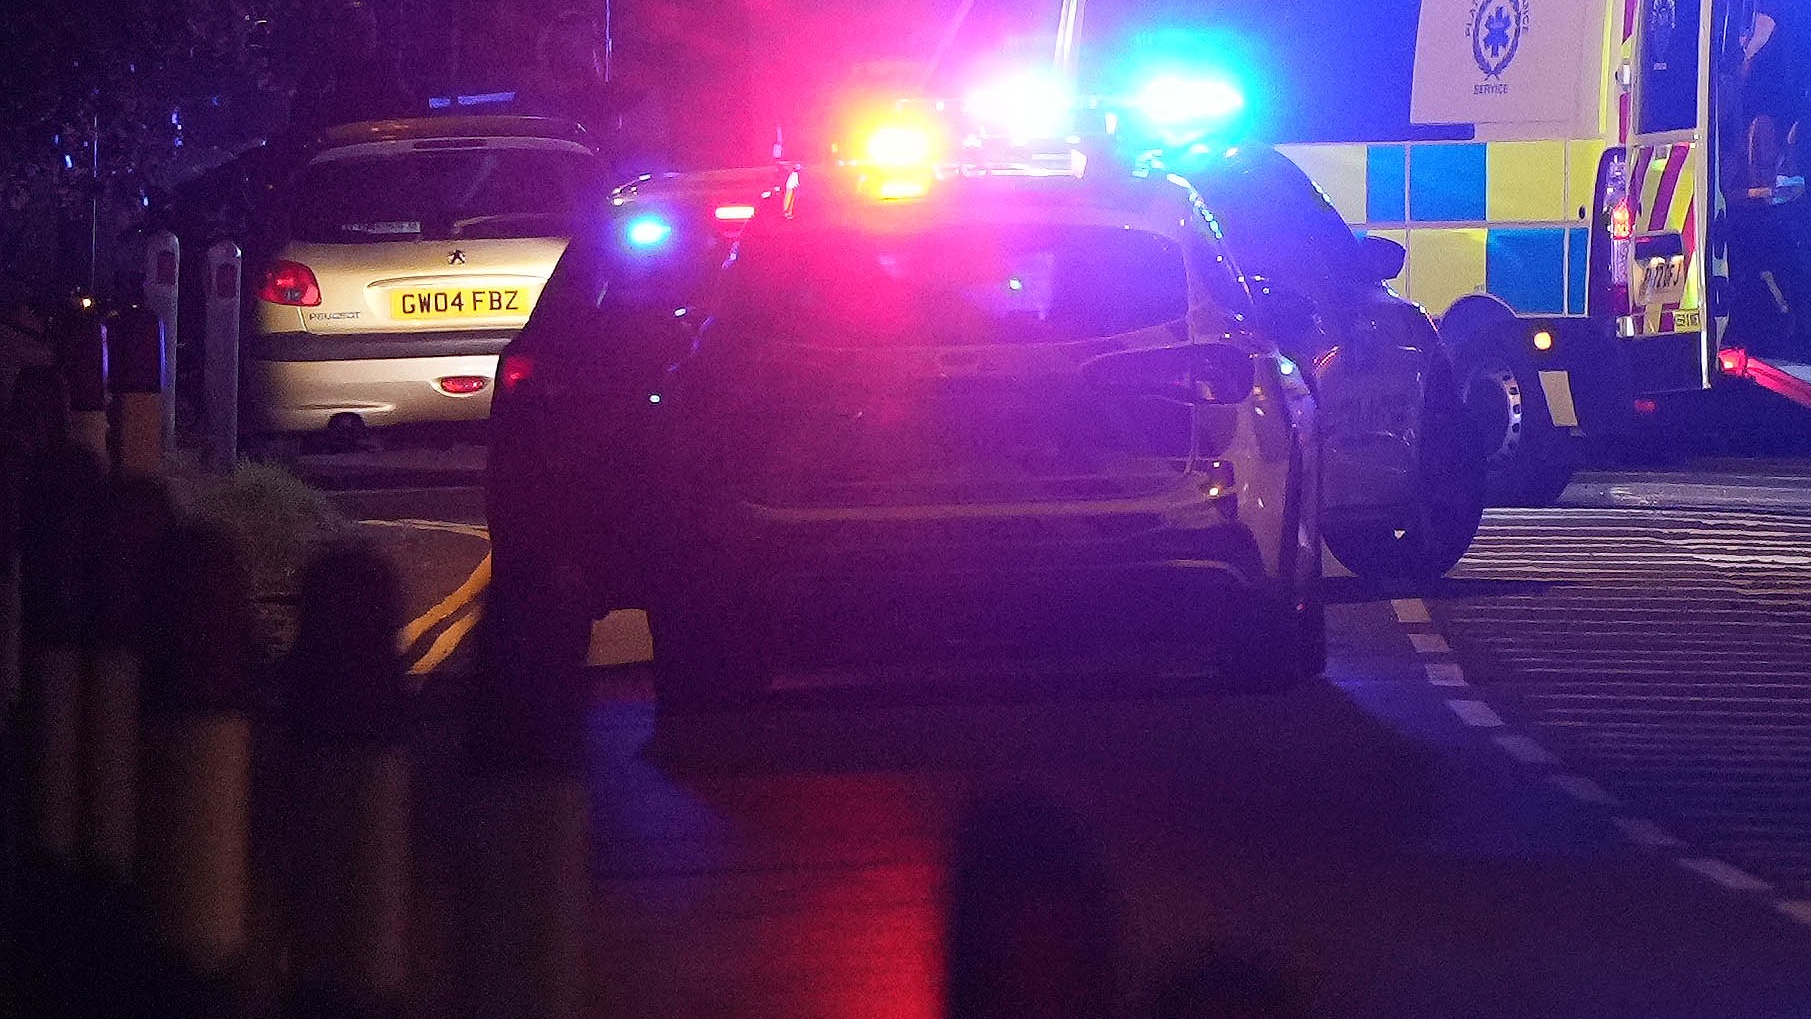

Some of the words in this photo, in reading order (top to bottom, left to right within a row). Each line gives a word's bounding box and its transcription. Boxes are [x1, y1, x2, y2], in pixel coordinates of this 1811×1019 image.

[1473, 83, 1509, 95] SERVICE
[402, 292, 464, 314] GW04
[472, 290, 519, 311] FBZ
